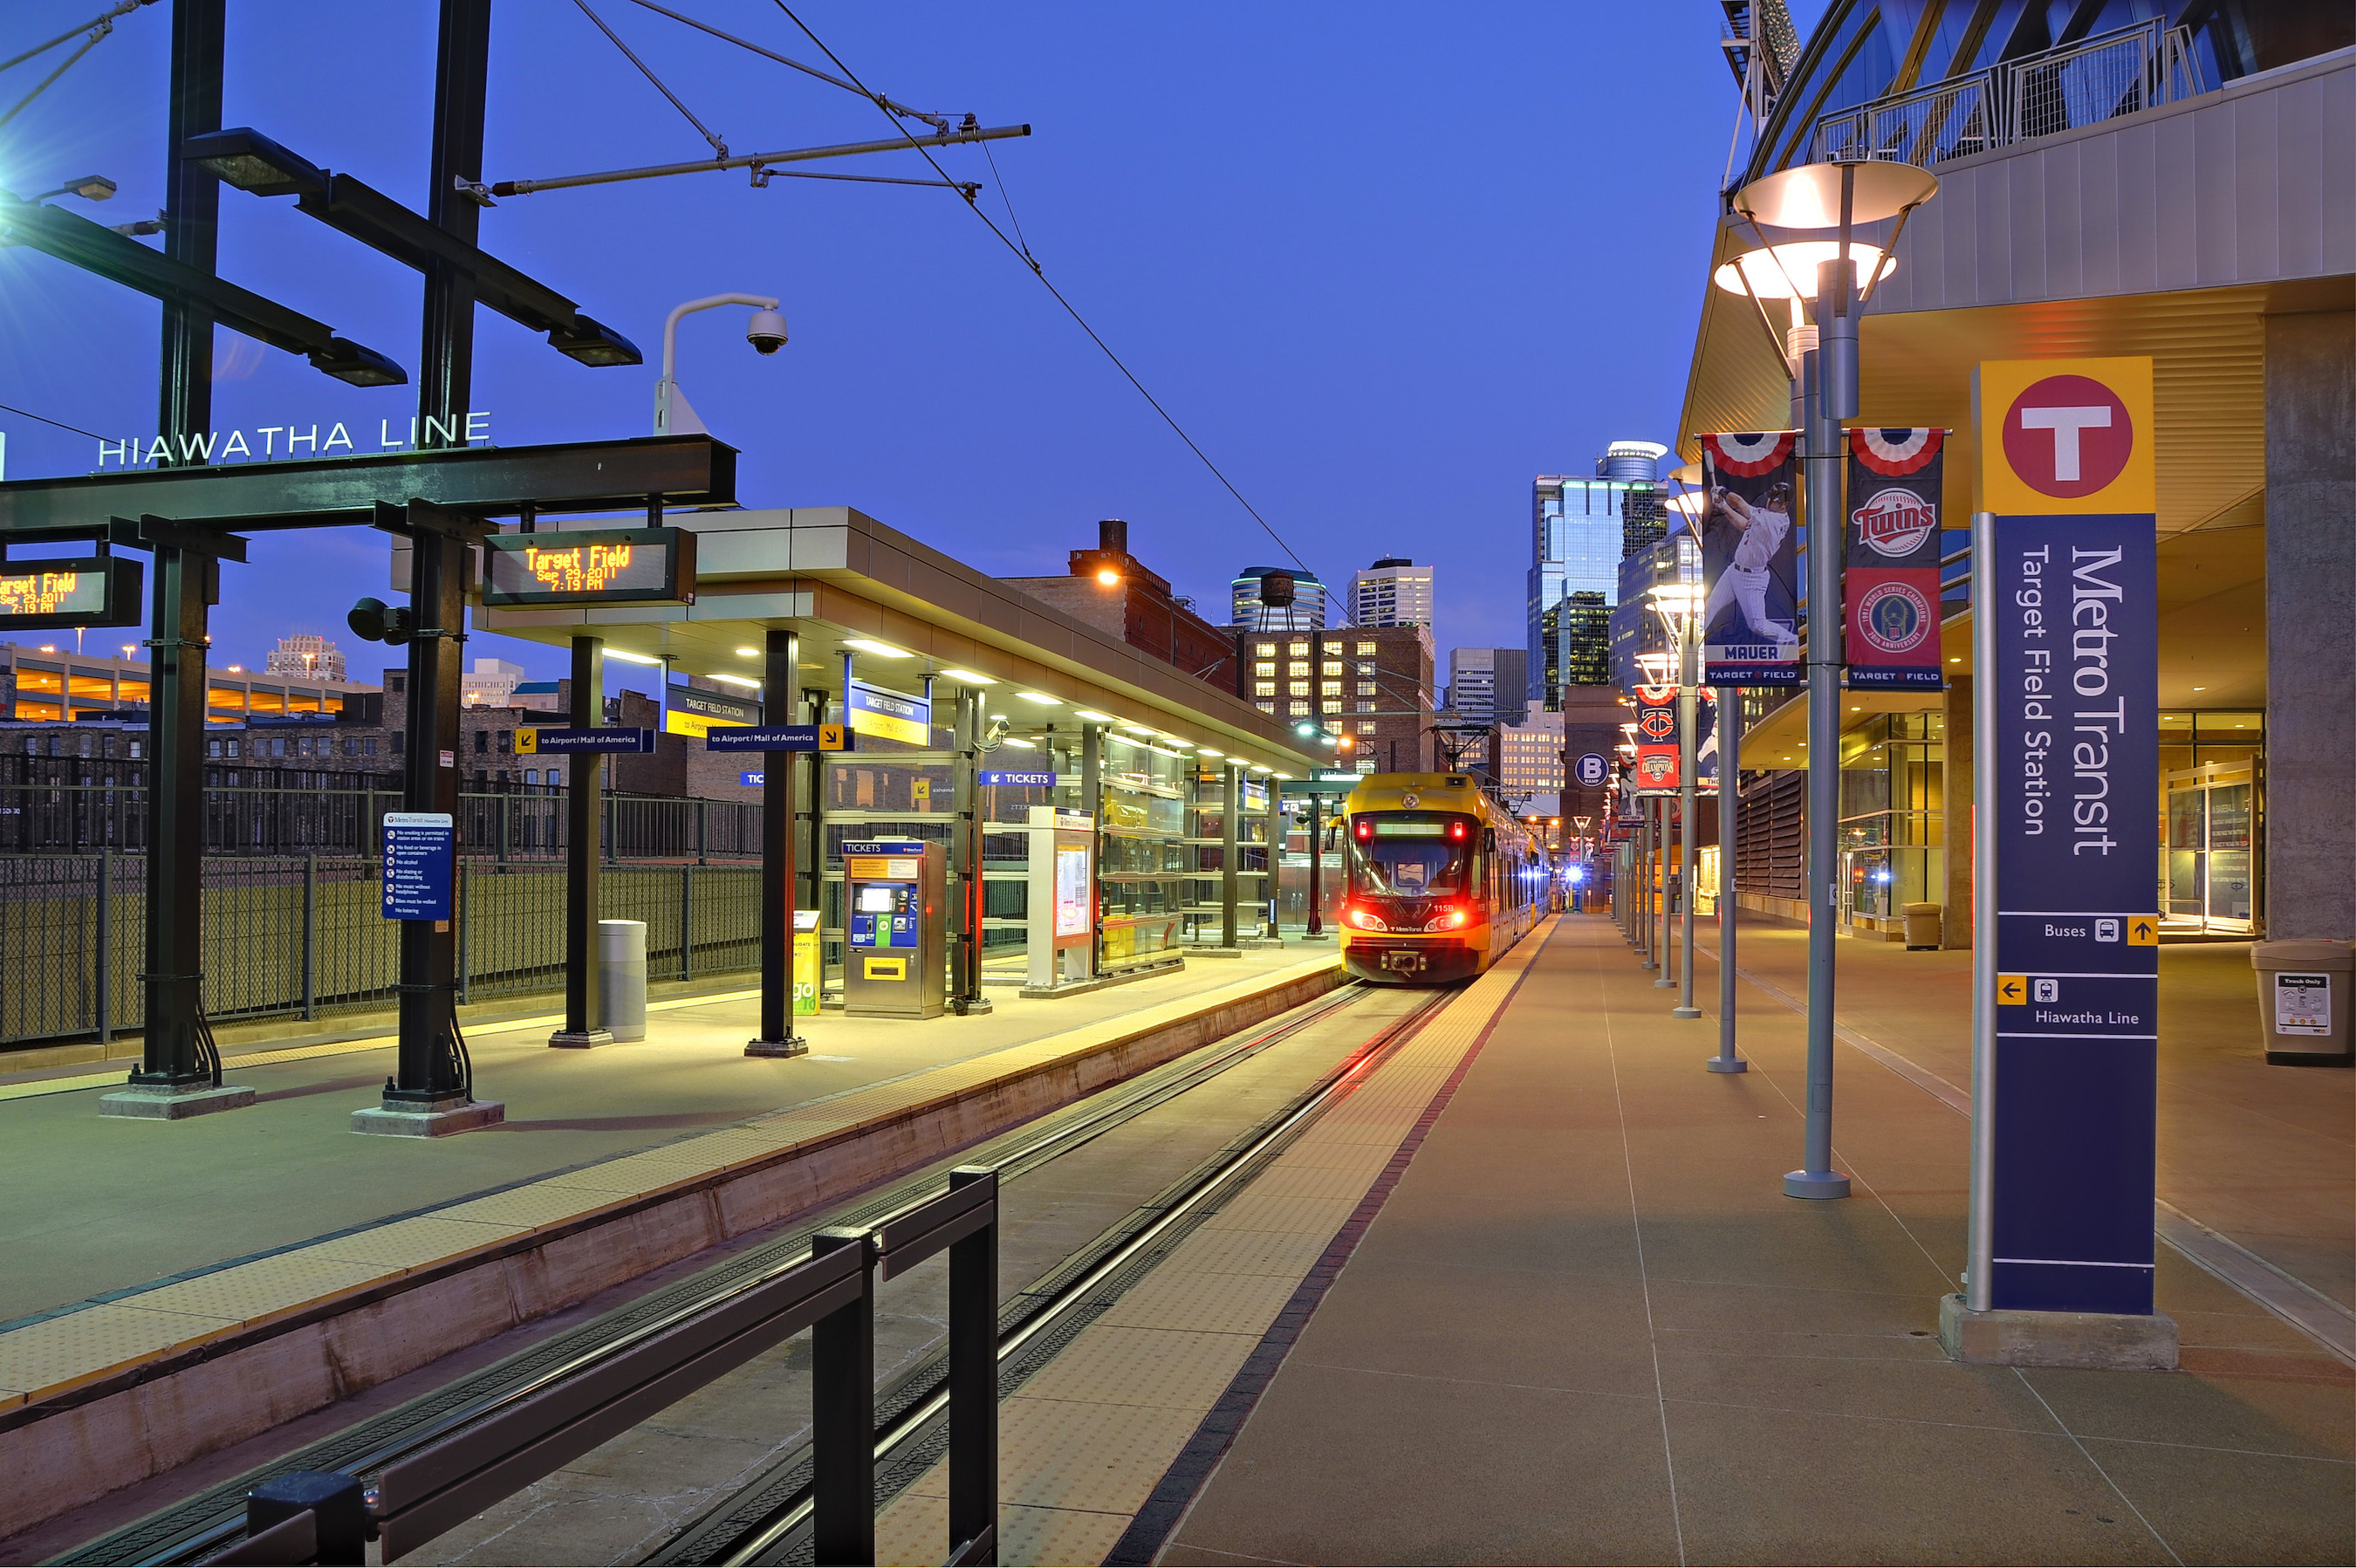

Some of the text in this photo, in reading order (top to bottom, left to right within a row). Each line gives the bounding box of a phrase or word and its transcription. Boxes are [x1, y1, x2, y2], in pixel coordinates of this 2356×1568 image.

[99, 412, 491, 467] HIAWATHA LINE
[2021, 406, 2112, 481] T
[1853, 503, 1935, 543] Twins
[525, 544, 631, 571] Target Field
[537, 567, 616, 582] Sep 29,2011
[43, 572, 77, 593] Field
[551, 579, 603, 592] 7:19 PM
[0, 592, 65, 605] Sep 29,2011
[1864, 590, 1883, 607] WORLD
[1883, 586, 1906, 595] SERIES
[1906, 590, 1928, 623] CHAMPIONS
[11, 603, 55, 614] 7:19 PM
[1881, 632, 1921, 648] ANNIVERSARY
[1724, 646, 1778, 660] MAUER
[1907, 672, 1939, 681] FIELD
[2016, 544, 2052, 836] Target Field Station
[685, 698, 744, 718] TARGET FIELD STATION
[865, 695, 914, 716] TARGET FIELD STATION
[1583, 757, 1602, 779] B
[1641, 761, 1674, 774] CHAMPIONS
[1005, 774, 1049, 784] TICKETS
[846, 844, 881, 852] TICKETS
[2044, 923, 2086, 937] Buses
[2035, 1010, 2140, 1024] Hiawatha Line
